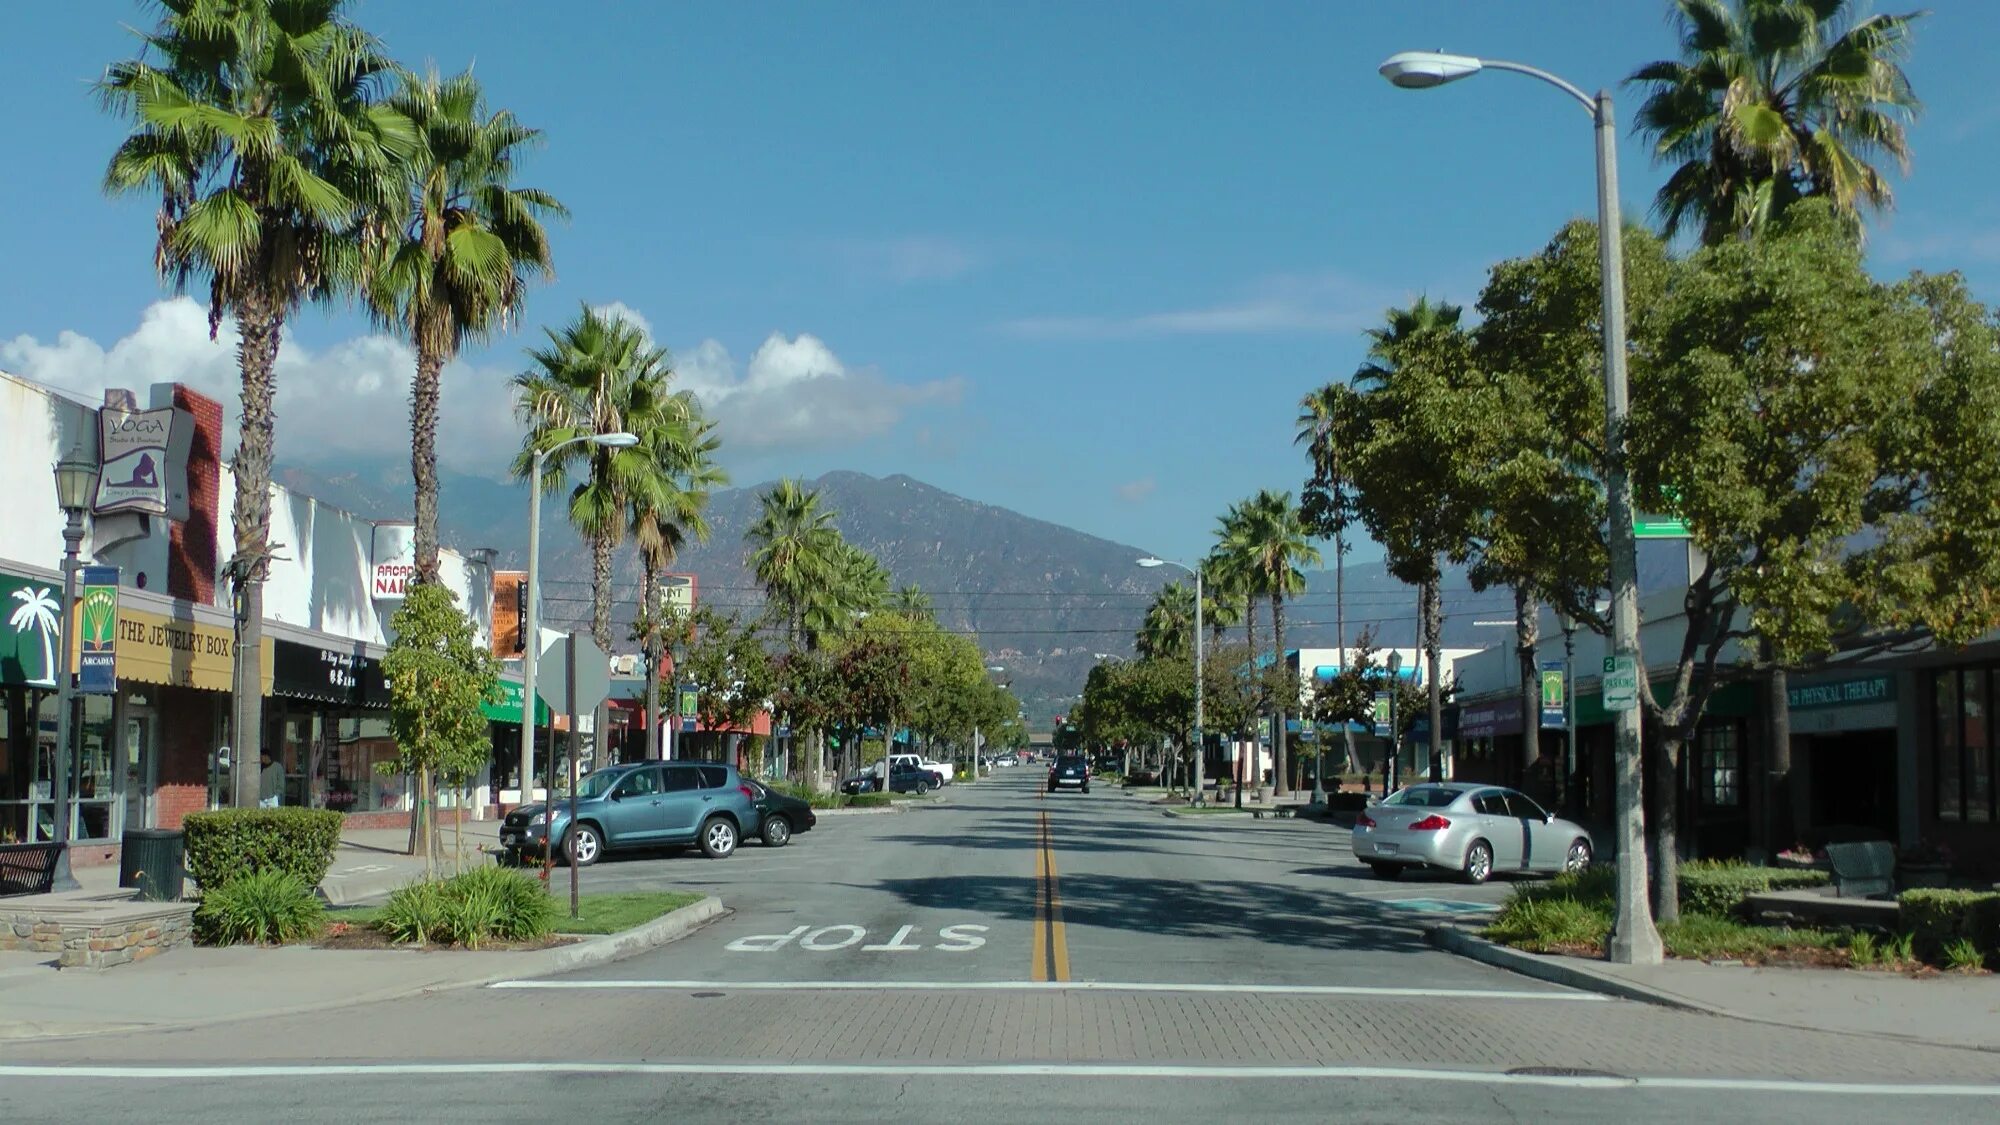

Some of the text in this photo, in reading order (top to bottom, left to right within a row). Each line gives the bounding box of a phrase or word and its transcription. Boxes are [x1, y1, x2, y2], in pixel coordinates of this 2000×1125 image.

[110, 419, 164, 435] YOGA
[119, 619, 145, 643] THE
[148, 625, 204, 653] JEWELRY
[206, 636, 229, 657] BOX
[82, 656, 115, 666] ARCADIA
[1605, 659, 1613, 671] 2
[1605, 678, 1634, 688] PARKING
[1801, 684, 1841, 705] PHYSICAL
[1844, 678, 1888, 700] THERAPY
[725, 924, 990, 951] STOP
